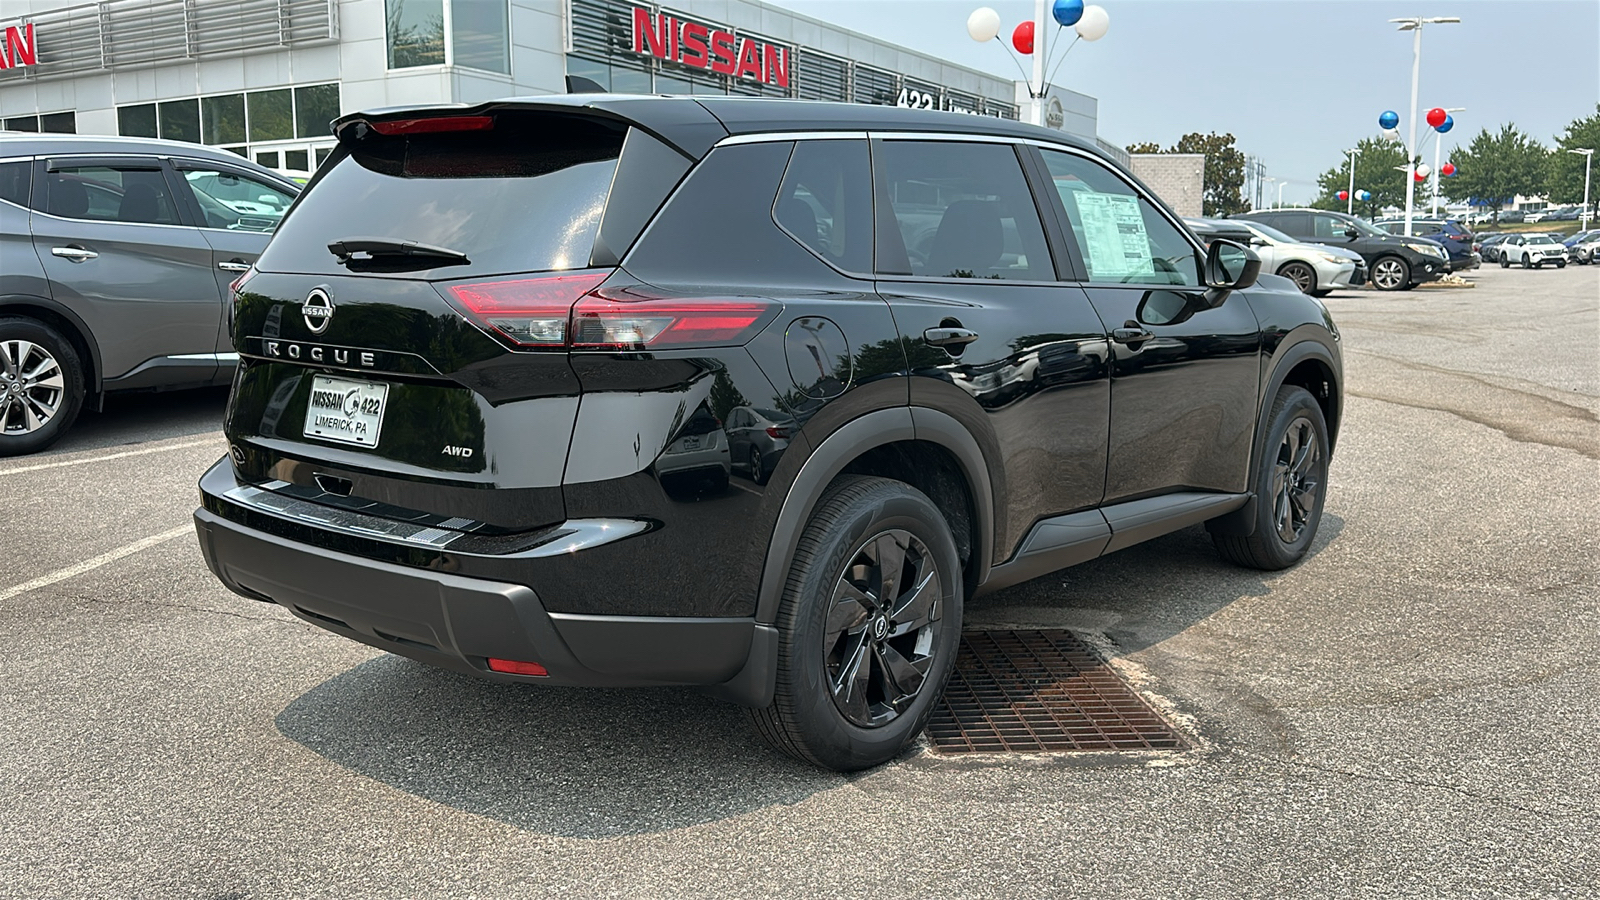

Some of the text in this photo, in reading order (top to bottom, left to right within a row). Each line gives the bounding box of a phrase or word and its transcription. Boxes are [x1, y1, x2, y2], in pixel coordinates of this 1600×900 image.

[632, 7, 789, 88] NISSAN
[897, 88, 933, 110] 422
[302, 307, 331, 317] NISSAN
[268, 342, 374, 366] ROGUE
[311, 390, 380, 415] NISSAN 422
[314, 415, 367, 434] LIMERICK, PA
[441, 444, 473, 458] AWD
